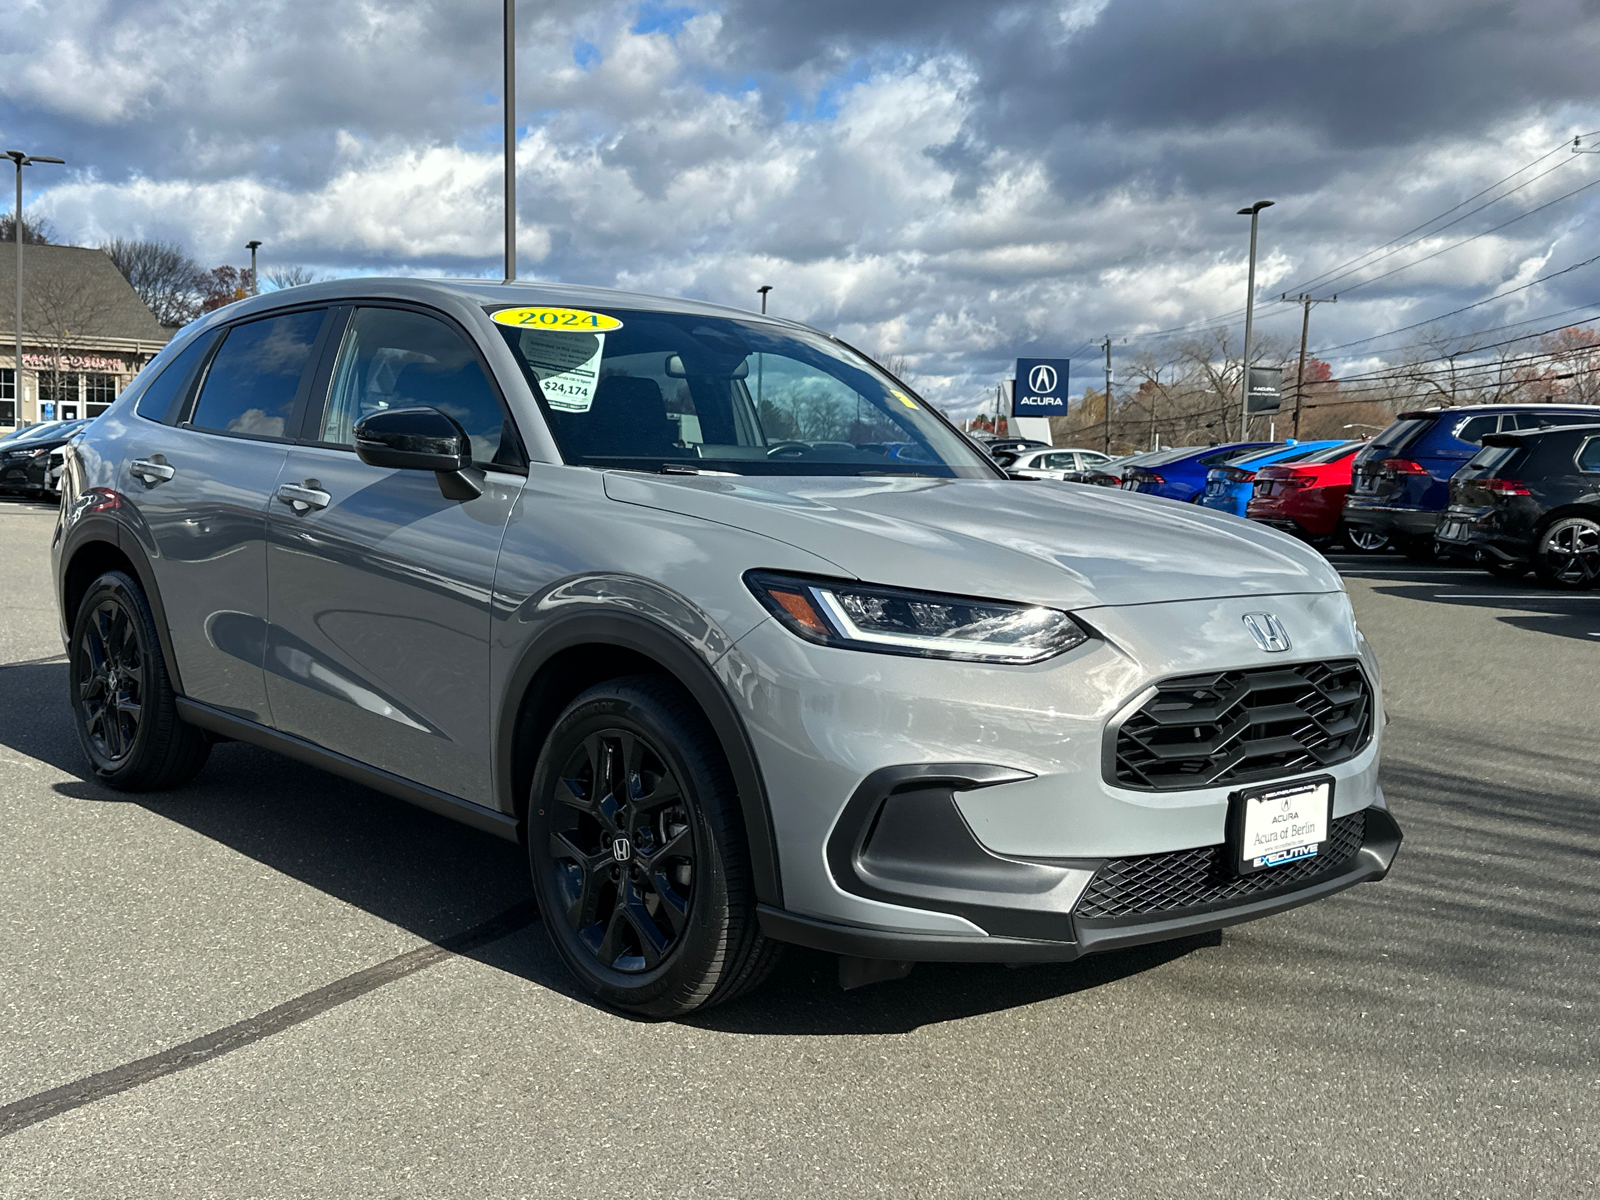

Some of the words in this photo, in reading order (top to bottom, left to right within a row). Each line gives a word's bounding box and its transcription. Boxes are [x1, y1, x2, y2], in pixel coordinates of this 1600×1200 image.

[518, 312, 601, 327] 2024
[544, 380, 588, 396] $24,174
[1020, 396, 1063, 406] ACURA
[1271, 811, 1299, 824] ACURA
[1254, 832, 1278, 846] Acura
[1280, 826, 1289, 840] of
[1291, 821, 1315, 837] Berlin
[1253, 843, 1318, 867] EXECUTIVE
